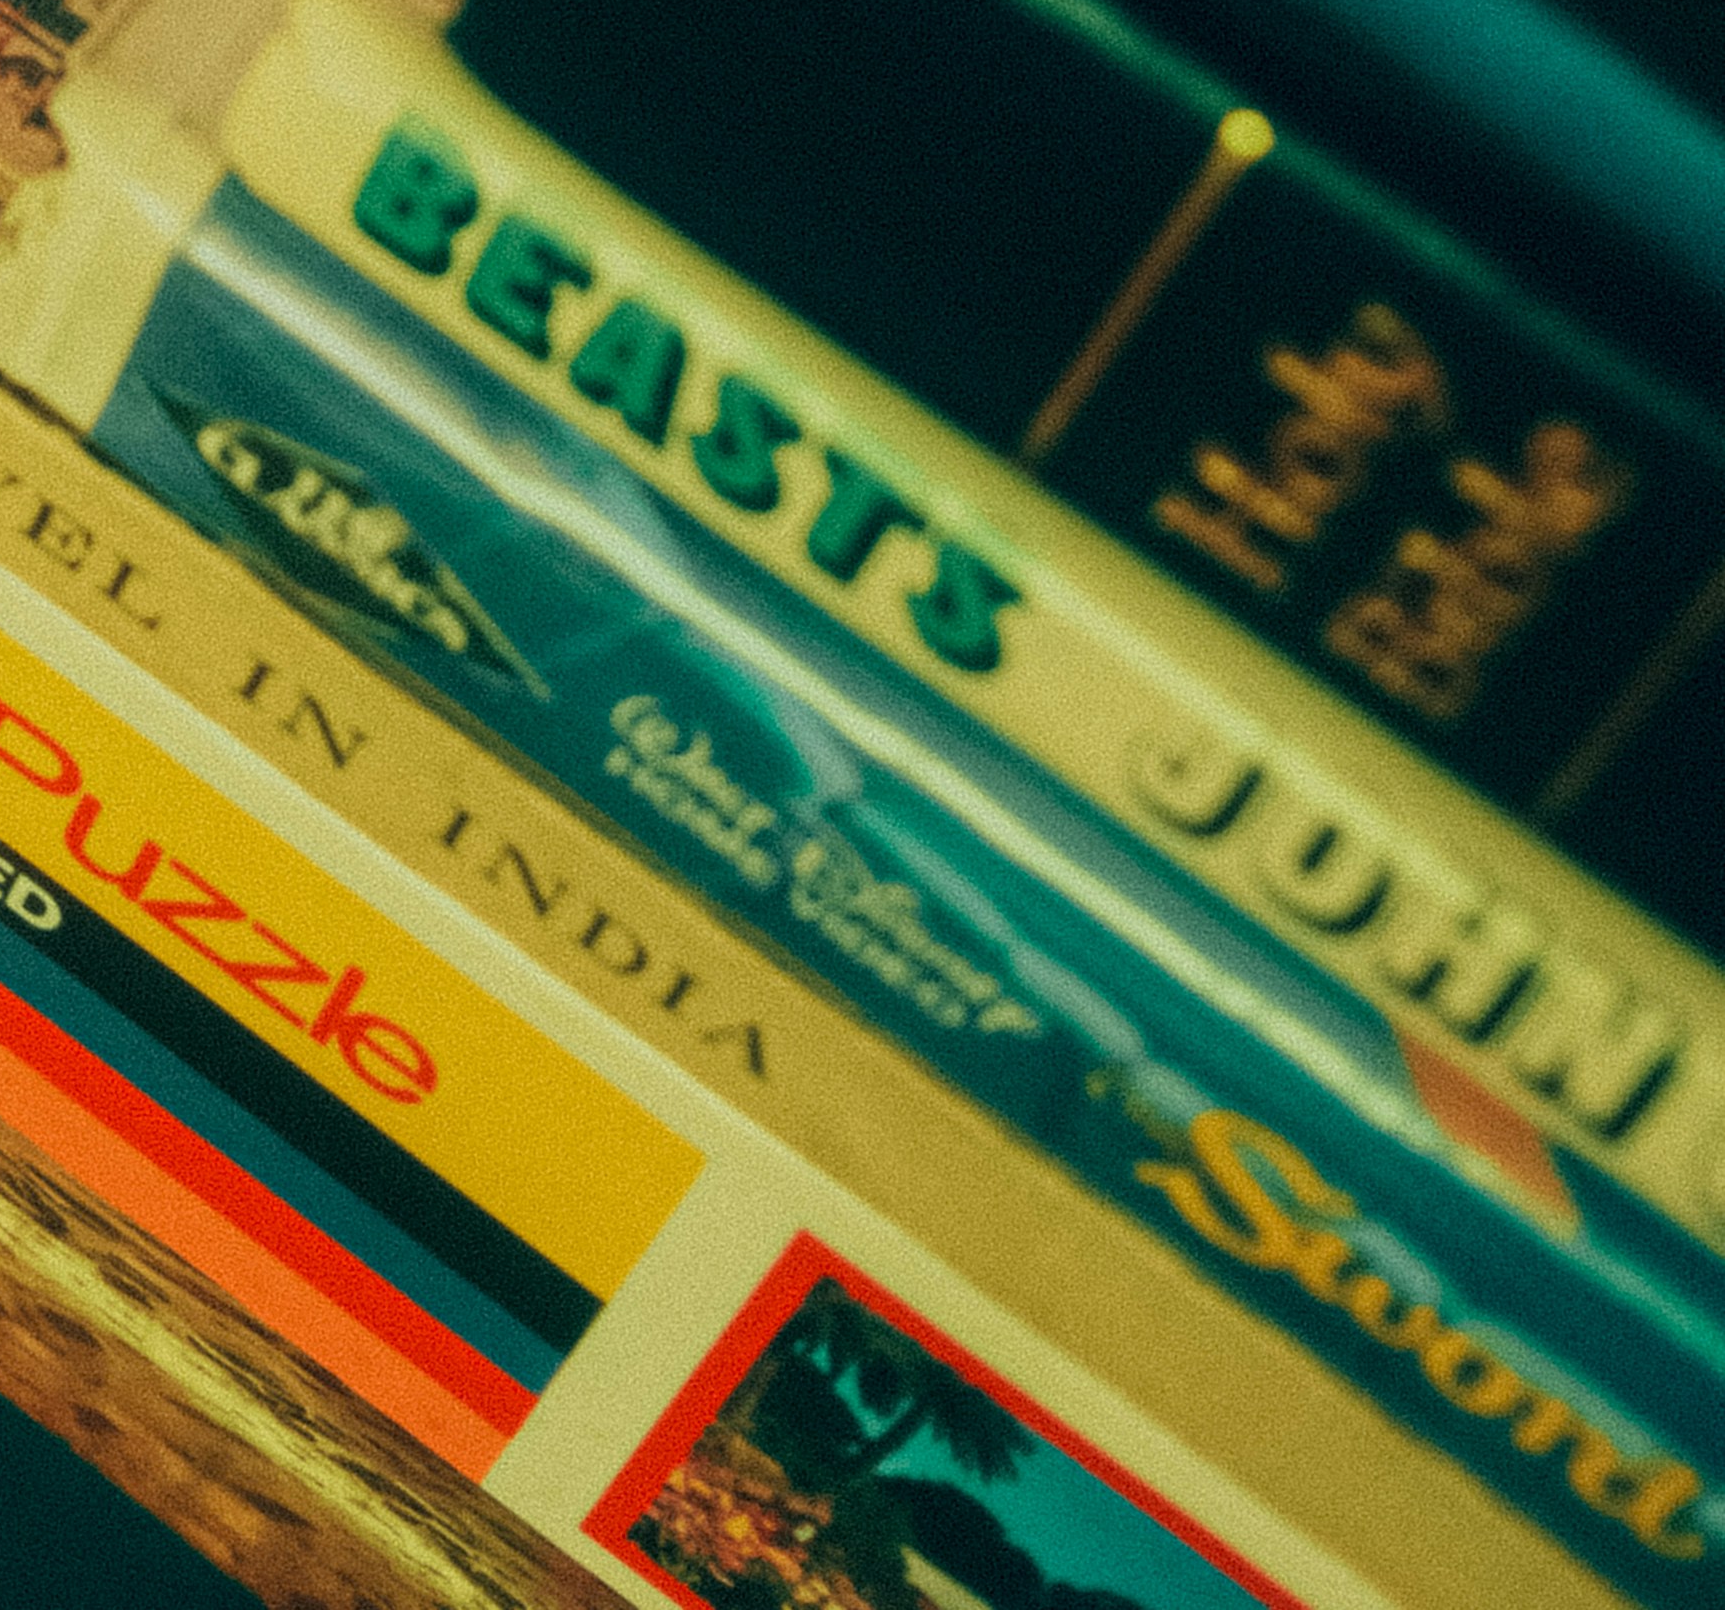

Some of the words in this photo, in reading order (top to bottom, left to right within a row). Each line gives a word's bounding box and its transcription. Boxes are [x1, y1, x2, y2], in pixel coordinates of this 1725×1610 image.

[352, 111, 1023, 673] BEASTS
[1129, 721, 1686, 1142] JOHN
[237, 662, 367, 769] IN
[438, 810, 768, 1078] INDIA
[1135, 1110, 1705, 1557] Sword
